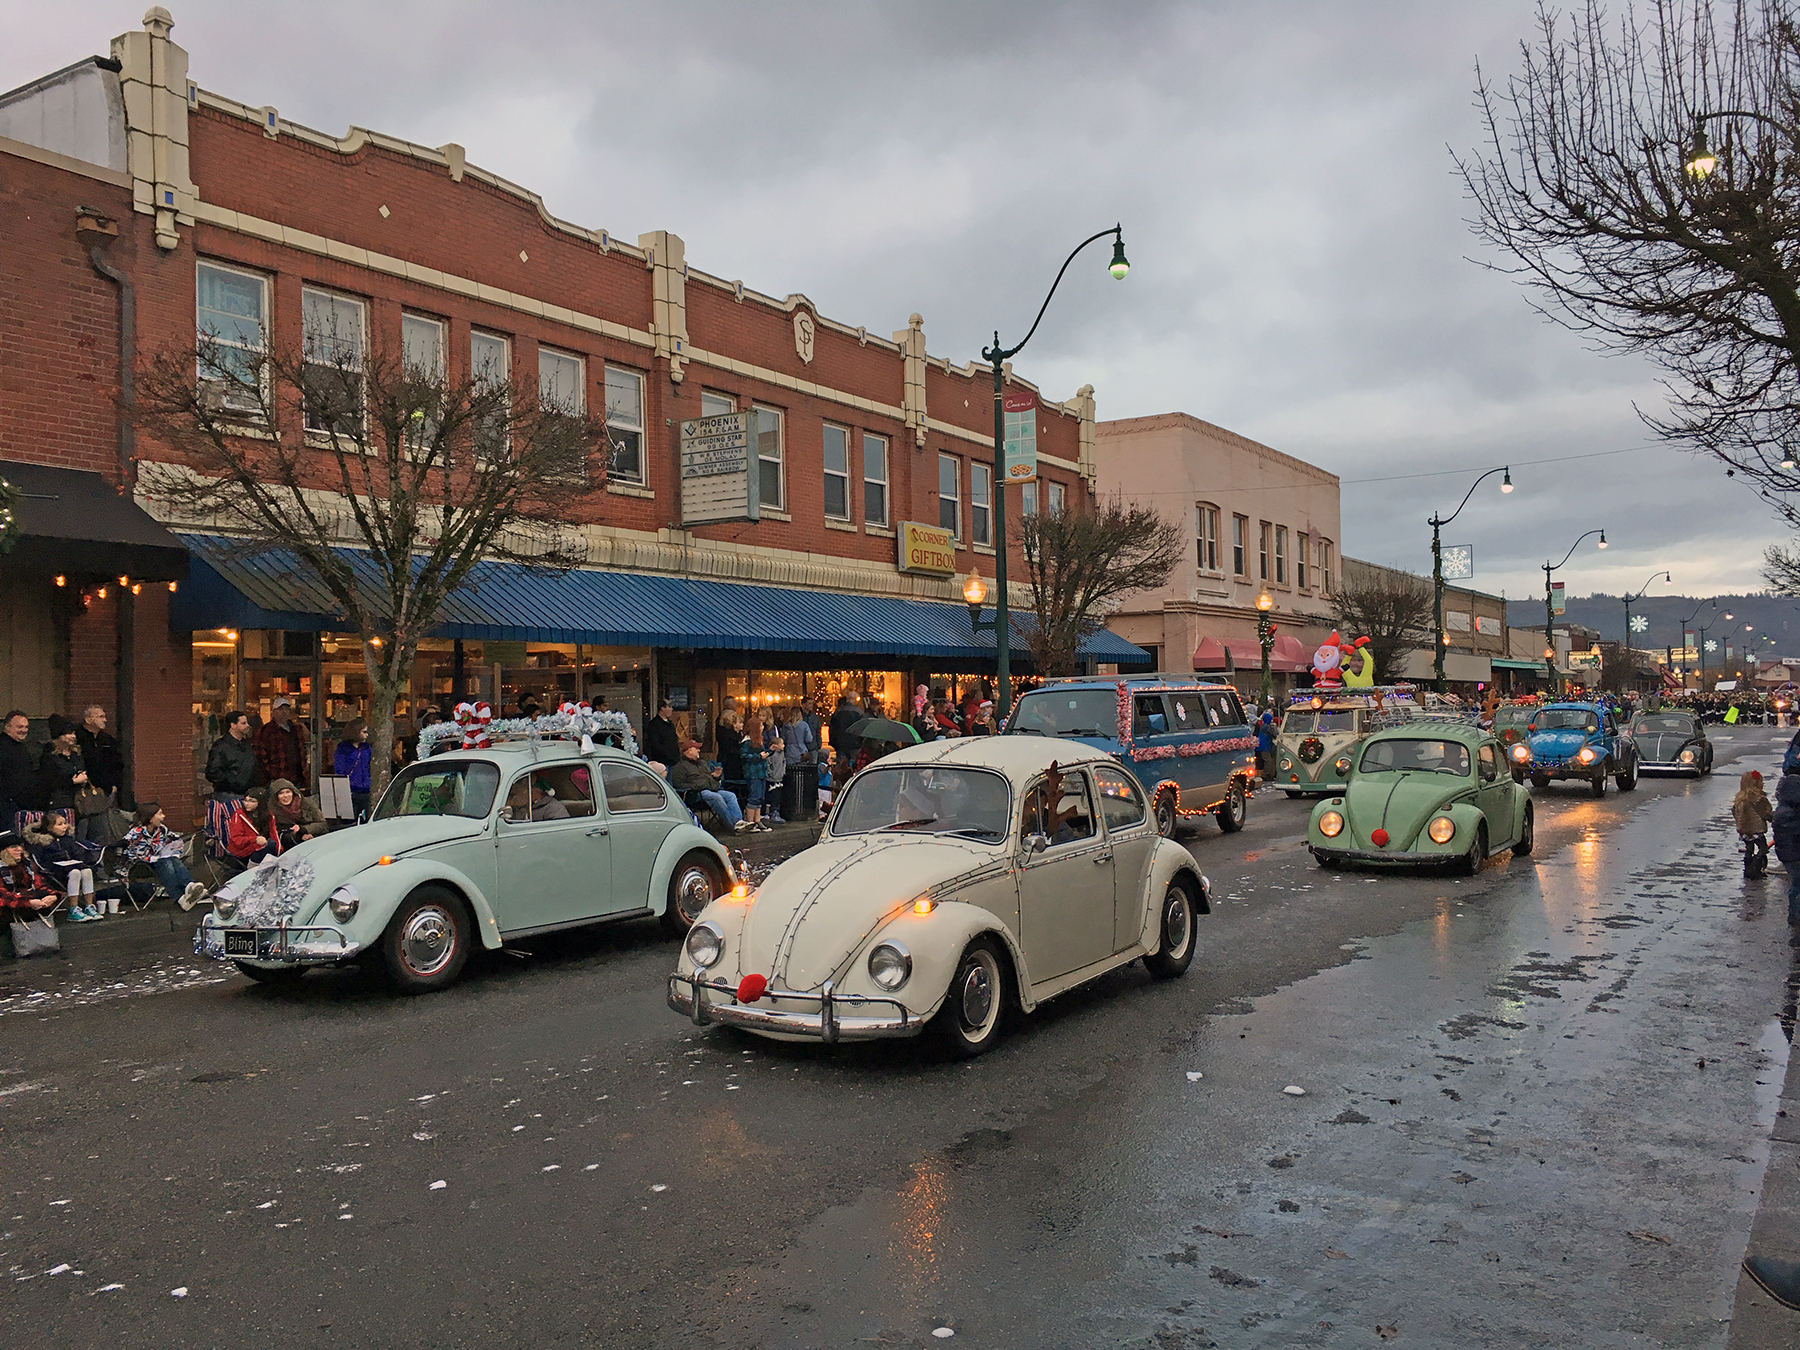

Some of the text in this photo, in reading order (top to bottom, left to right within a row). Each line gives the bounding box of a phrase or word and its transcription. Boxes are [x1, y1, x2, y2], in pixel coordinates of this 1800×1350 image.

[700, 416, 738, 428] PHOENIX
[700, 428, 712, 436] 154
[698, 436, 725, 445] GUIDING
[918, 531, 949, 546] CORNER
[911, 549, 955, 568] GIFTBOX
[228, 936, 254, 954] Bling
